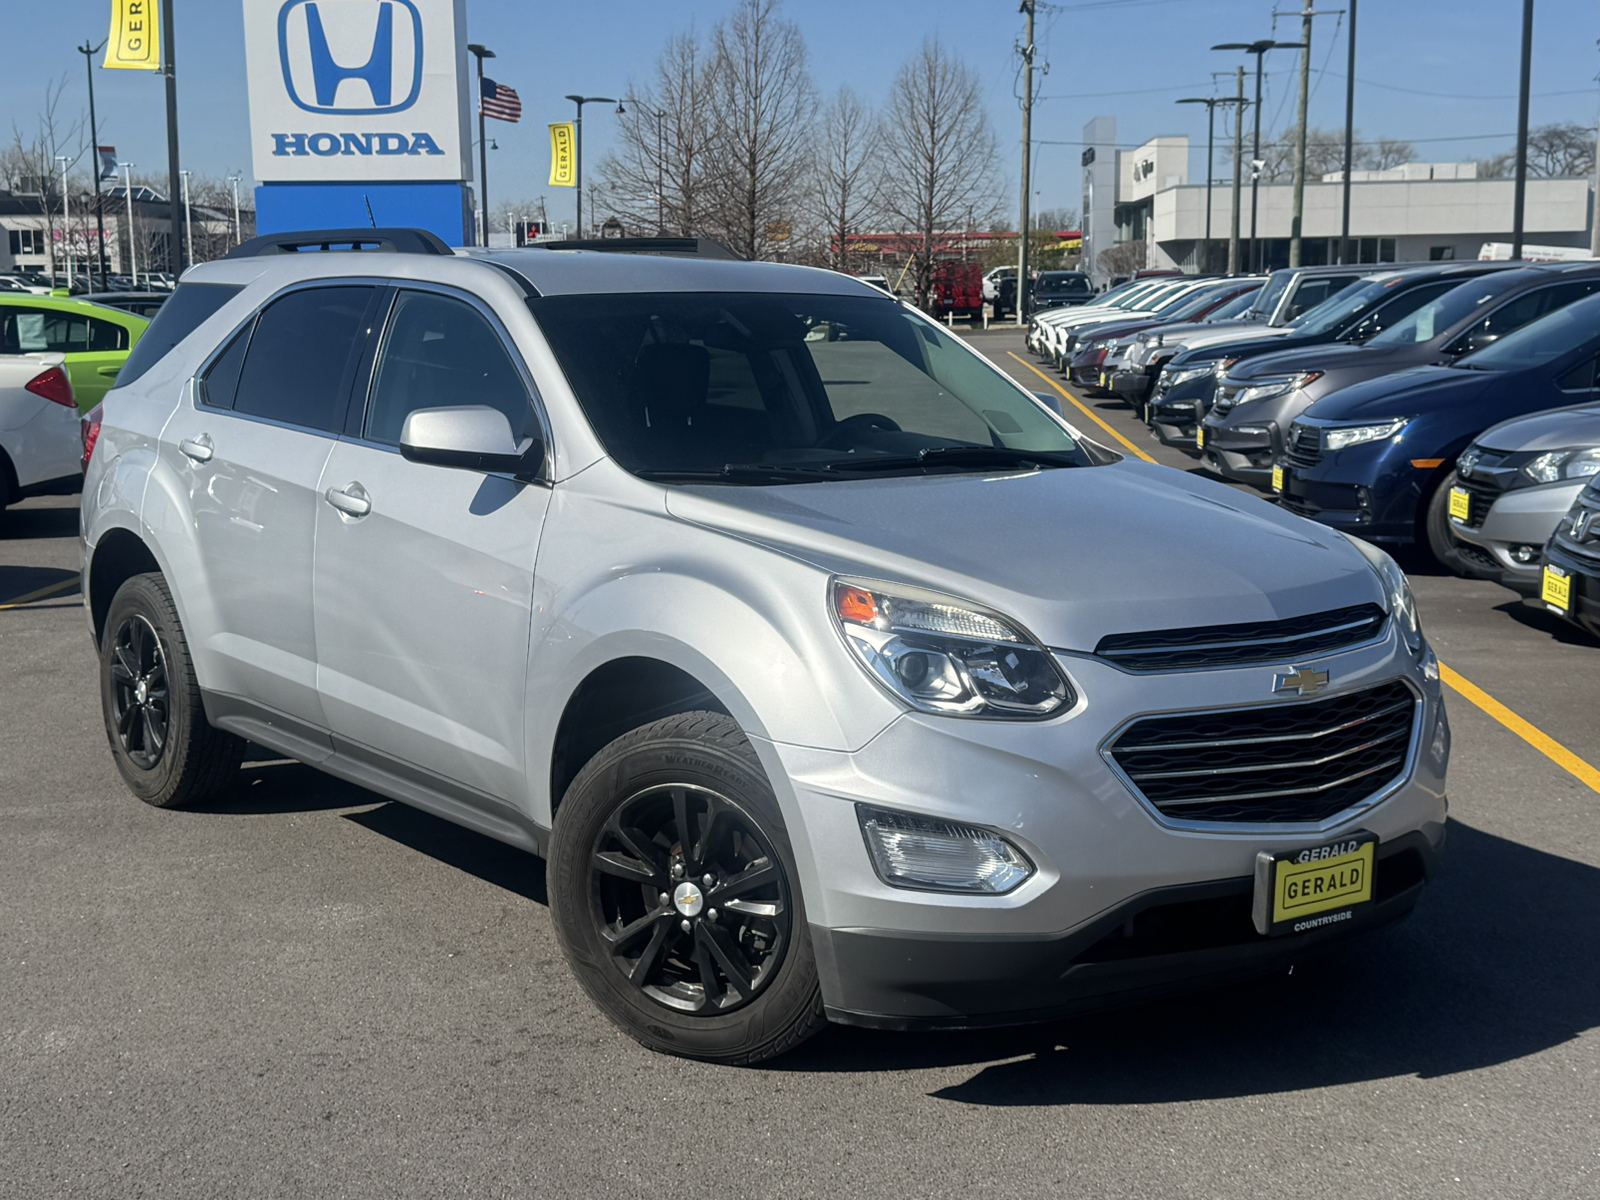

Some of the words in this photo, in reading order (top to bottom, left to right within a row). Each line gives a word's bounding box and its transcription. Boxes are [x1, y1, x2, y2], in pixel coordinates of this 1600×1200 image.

[271, 132, 446, 157] HONDA
[558, 130, 568, 178] GERALD
[1547, 581, 1567, 598] GERALD
[1298, 840, 1357, 864] GERALD
[1287, 868, 1360, 899] GERALD
[1294, 910, 1352, 932] COUNTRYSIDE
